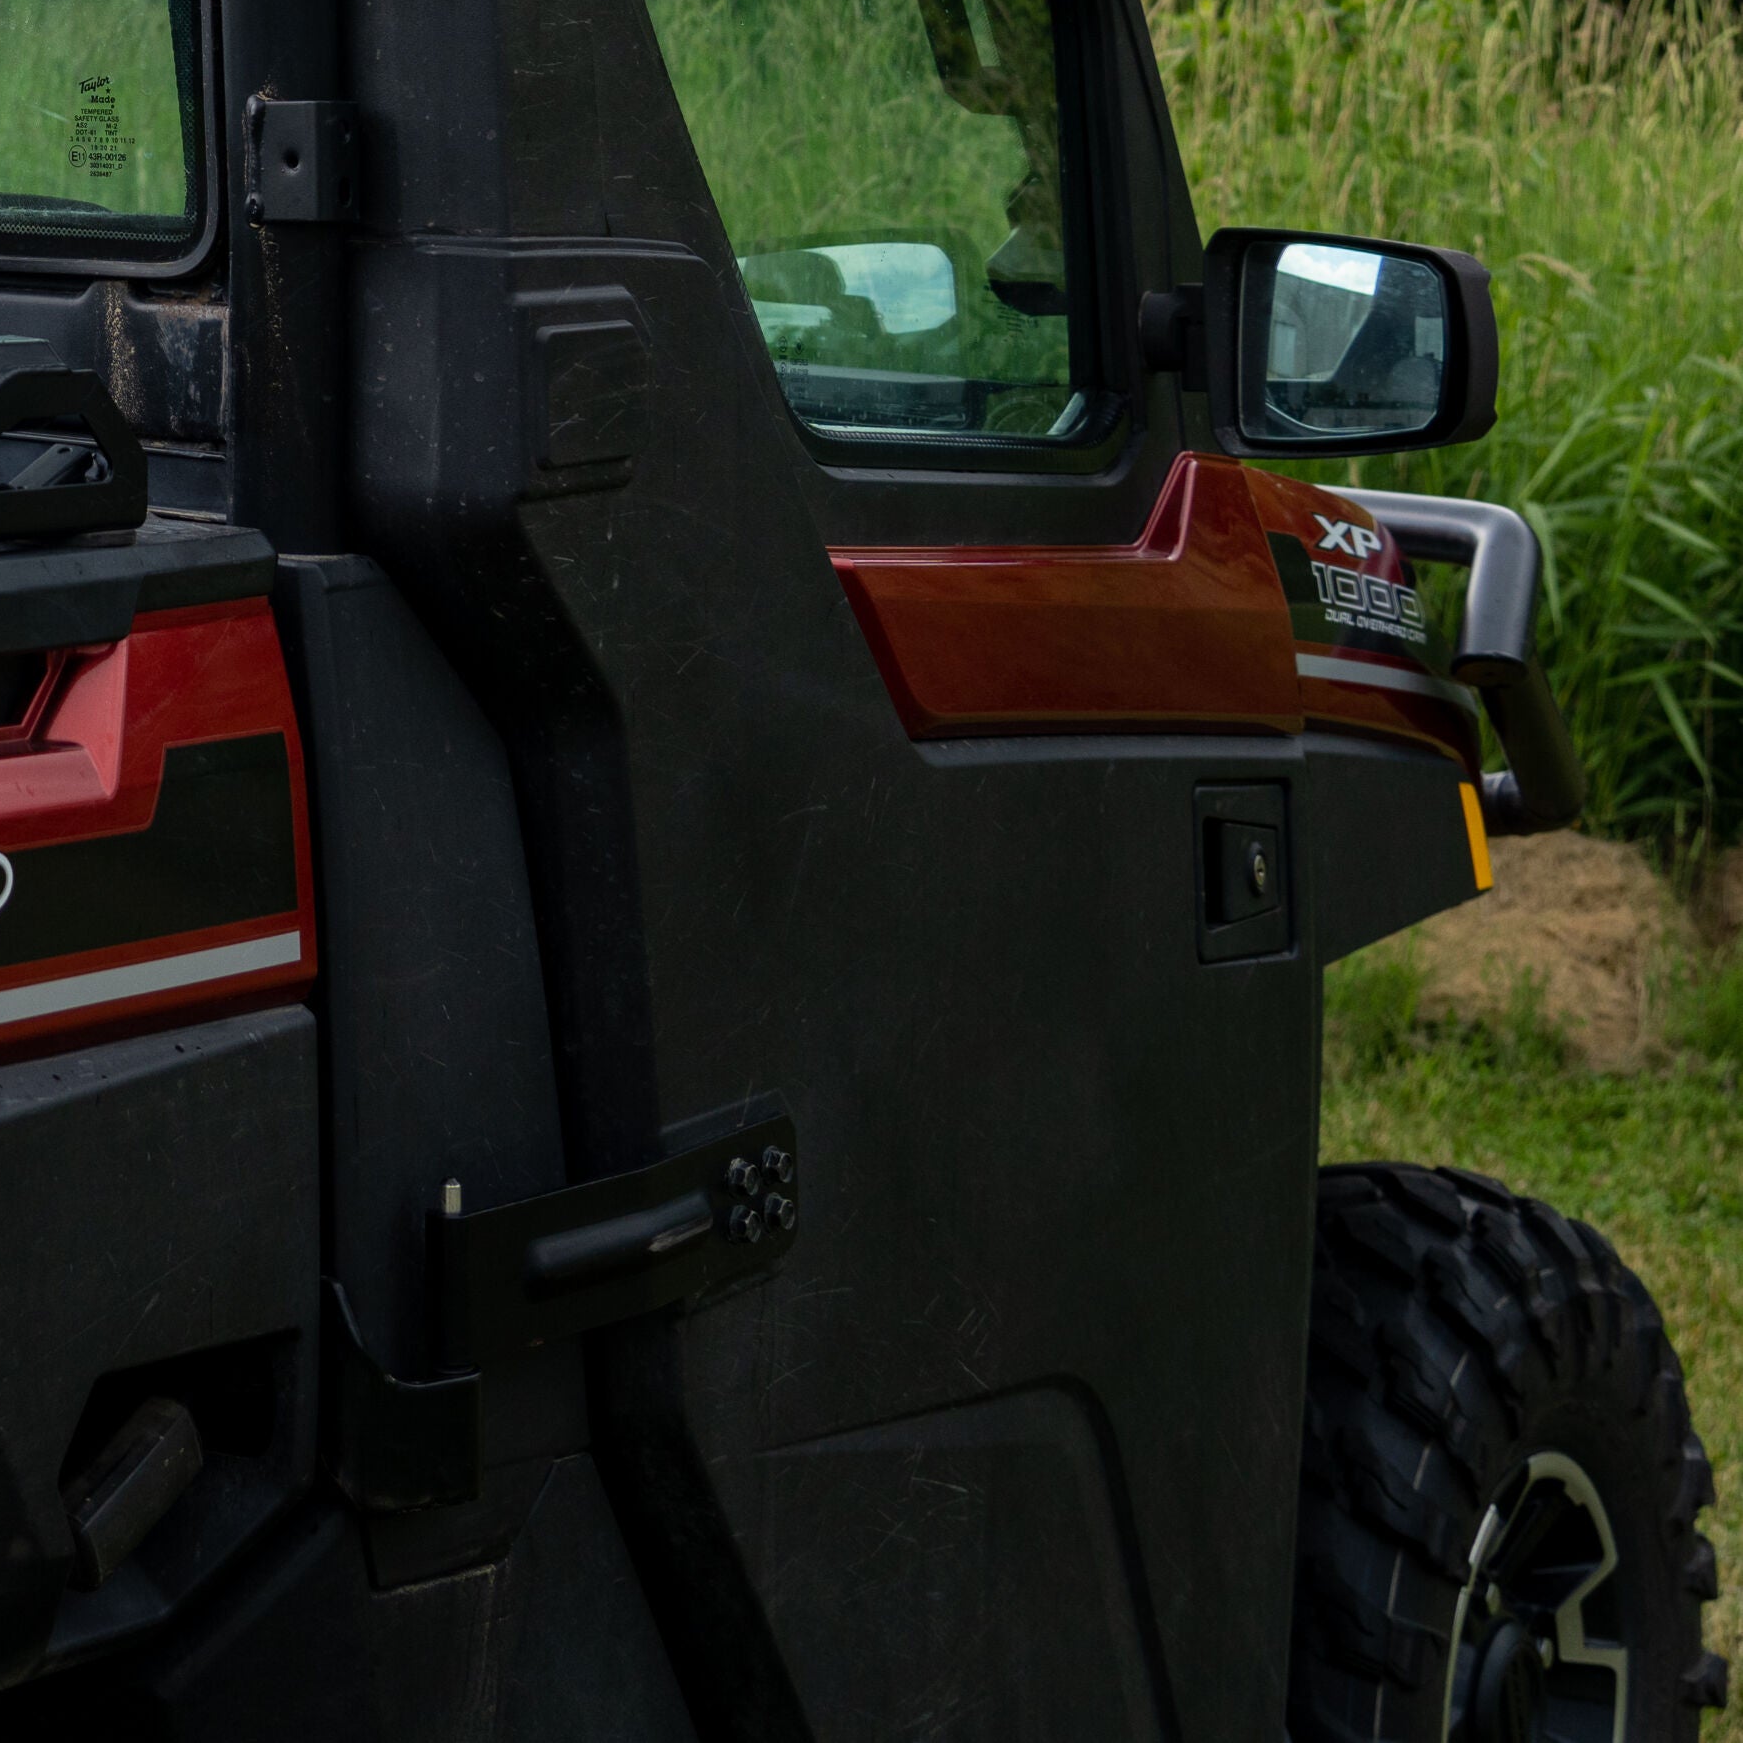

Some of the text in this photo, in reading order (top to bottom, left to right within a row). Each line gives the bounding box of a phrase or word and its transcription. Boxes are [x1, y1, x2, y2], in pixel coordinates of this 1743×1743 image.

[79, 76, 110, 94] Taylor
[90, 95, 116, 104] Made
[81, 108, 113, 116] TEMPERED
[98, 115, 120, 123] GLASS
[1313, 513, 1382, 559] XP
[1310, 560, 1426, 629] 1000
[1325, 608, 1356, 627] DUAL
